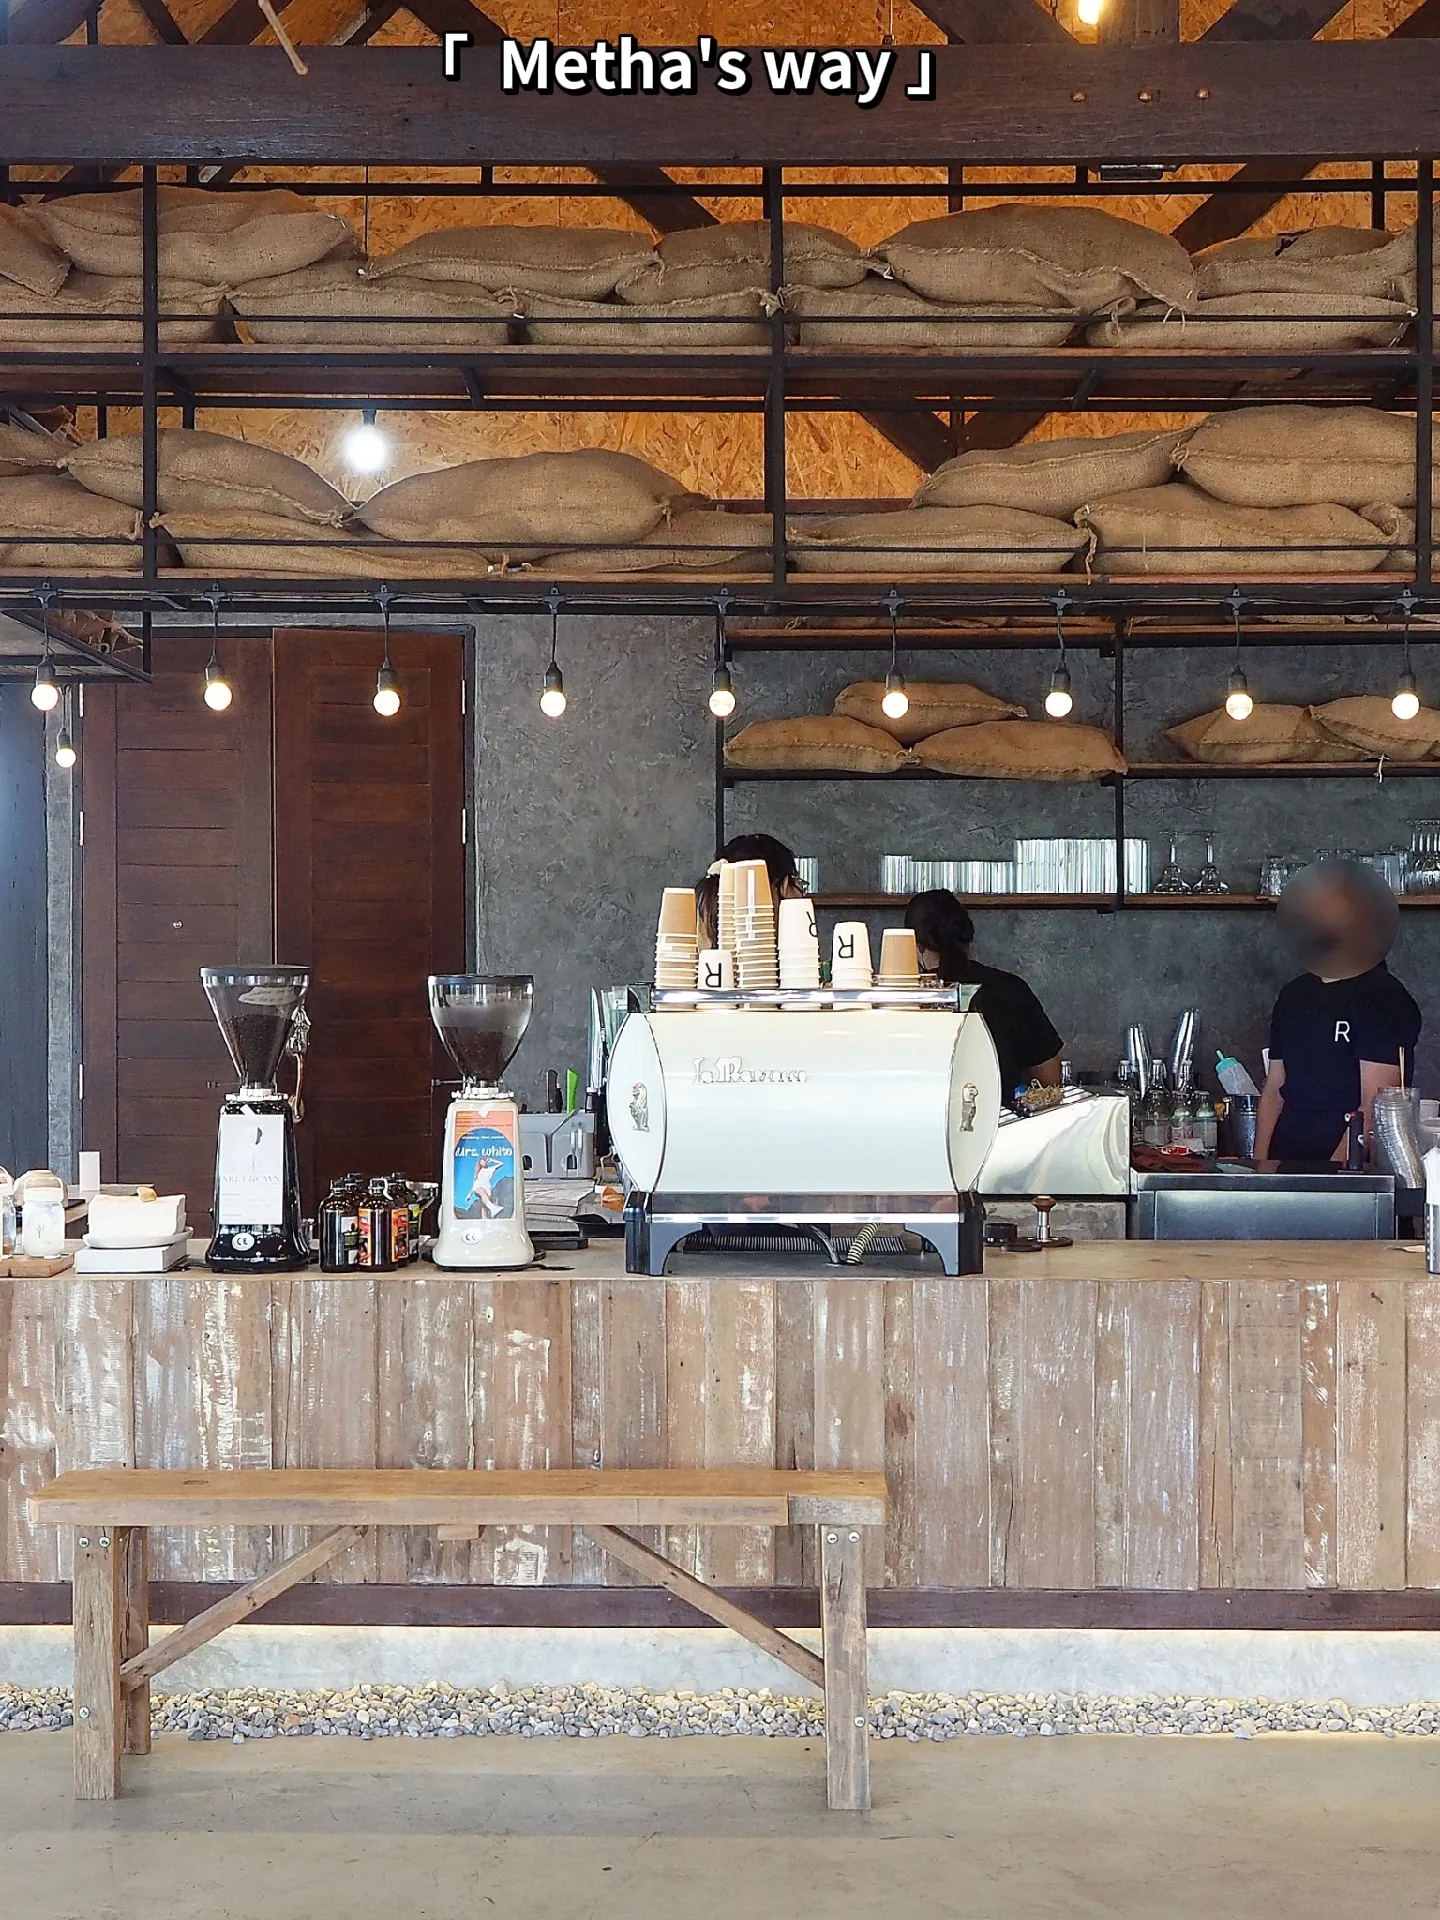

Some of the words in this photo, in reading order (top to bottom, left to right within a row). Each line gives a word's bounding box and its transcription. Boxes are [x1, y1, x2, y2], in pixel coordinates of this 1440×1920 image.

[838, 934, 854, 959] R
[705, 962, 722, 988] R
[1335, 1020, 1351, 1043] R
